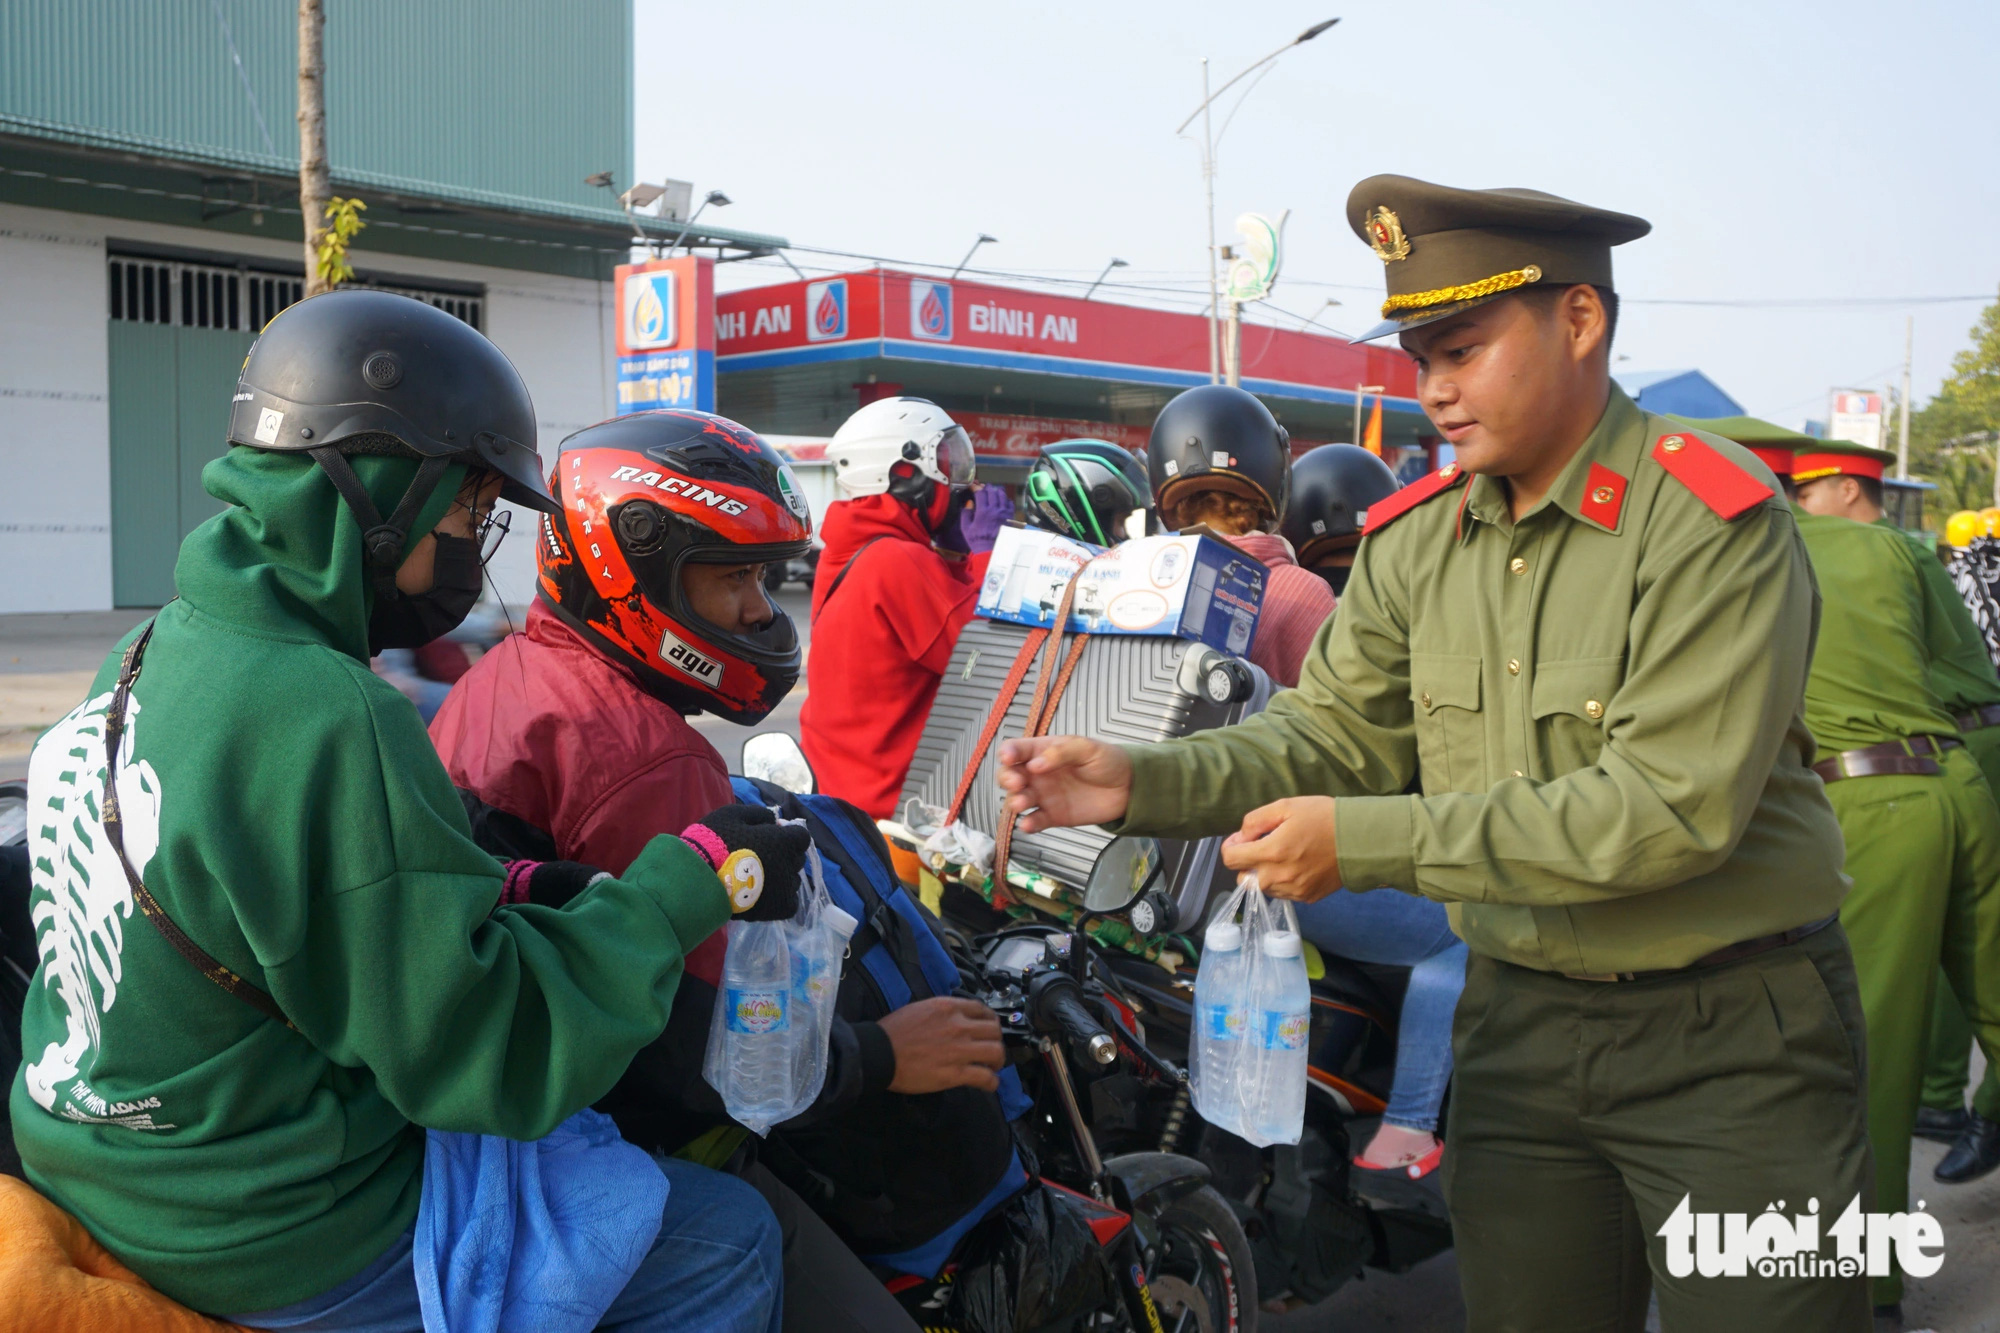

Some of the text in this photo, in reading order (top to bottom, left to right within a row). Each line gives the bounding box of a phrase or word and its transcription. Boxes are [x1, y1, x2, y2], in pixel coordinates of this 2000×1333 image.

[715, 304, 792, 341] NH AN
[969, 300, 1077, 343] BÌNH AN
[681, 375, 692, 400] 7
[609, 465, 749, 518] RACING
[543, 512, 561, 556] ACING
[573, 457, 613, 580] ENERGY
[70, 1079, 92, 1101] THE
[110, 1096, 162, 1115] ADAMS
[1139, 1284, 1165, 1333] RACIN
